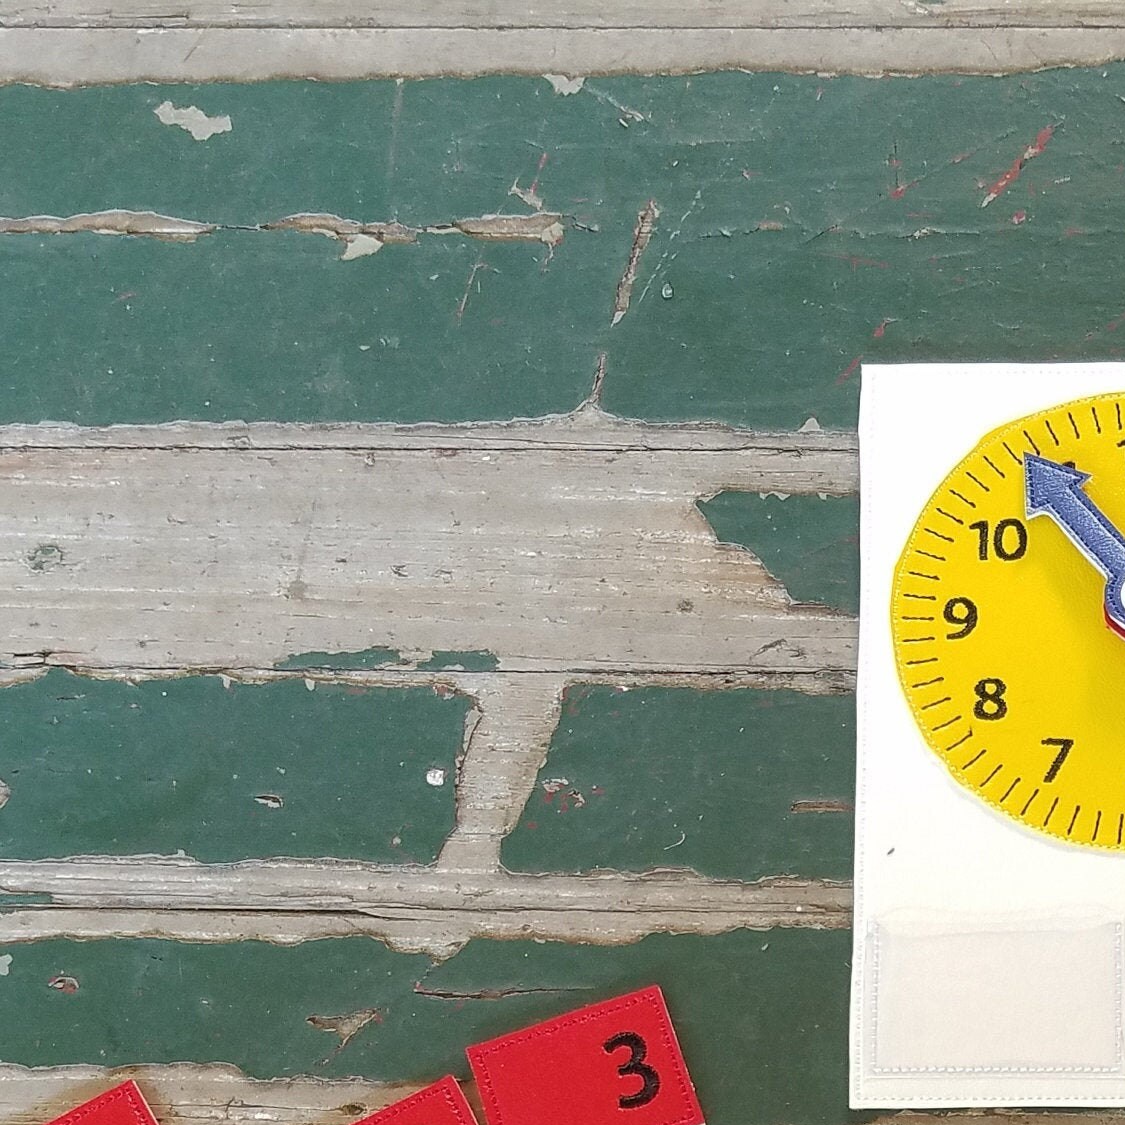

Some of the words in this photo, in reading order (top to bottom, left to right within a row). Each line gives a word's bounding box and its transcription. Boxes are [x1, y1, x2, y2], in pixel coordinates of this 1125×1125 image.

[969, 518, 1028, 561] 10
[943, 597, 978, 640] 9
[974, 678, 1007, 721] 8
[1041, 738, 1074, 783] 7
[603, 1032, 660, 1109] 3
